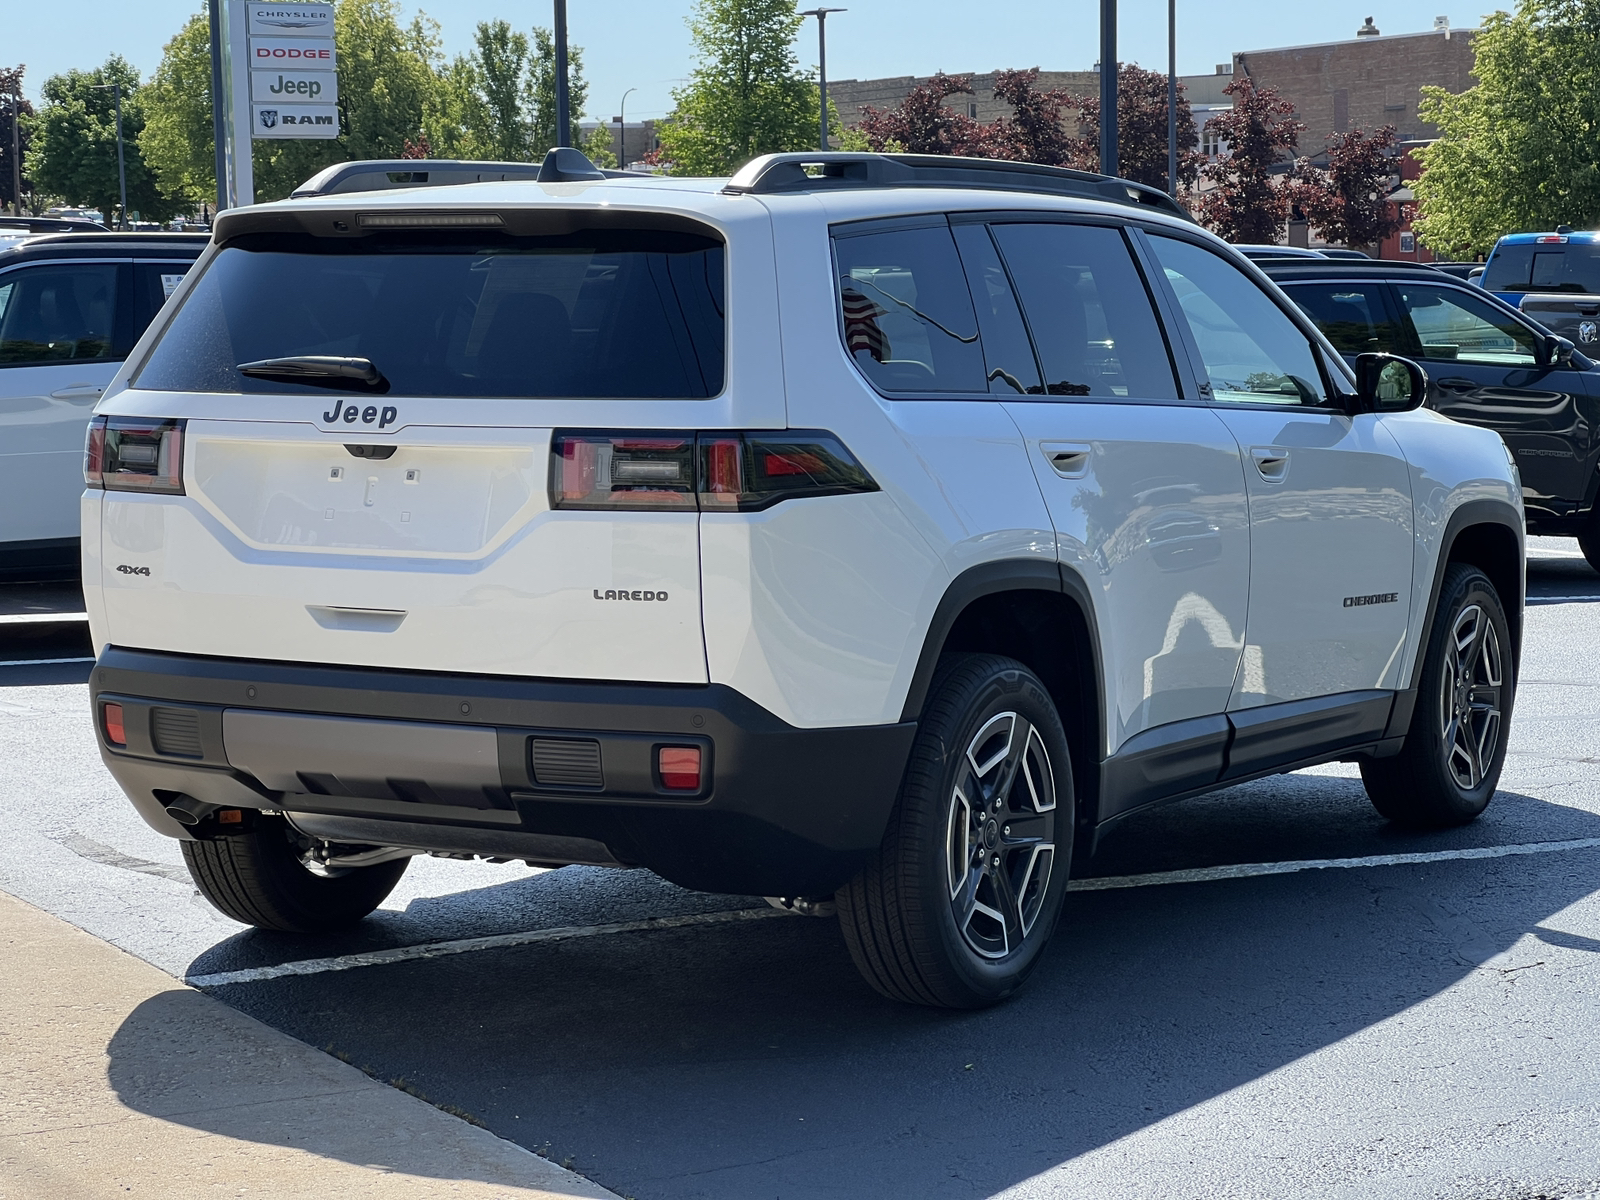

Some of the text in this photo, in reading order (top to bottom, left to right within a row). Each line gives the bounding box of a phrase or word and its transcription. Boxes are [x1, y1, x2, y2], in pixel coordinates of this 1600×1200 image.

[256, 11, 327, 19] CHRYSLER
[256, 48, 331, 59] DODGE
[269, 75, 322, 98] Jeep
[282, 115, 333, 125] RAM
[322, 399, 398, 429] Jeep
[593, 589, 669, 602] LAREDO
[1343, 592, 1399, 608] CHEROKEE
